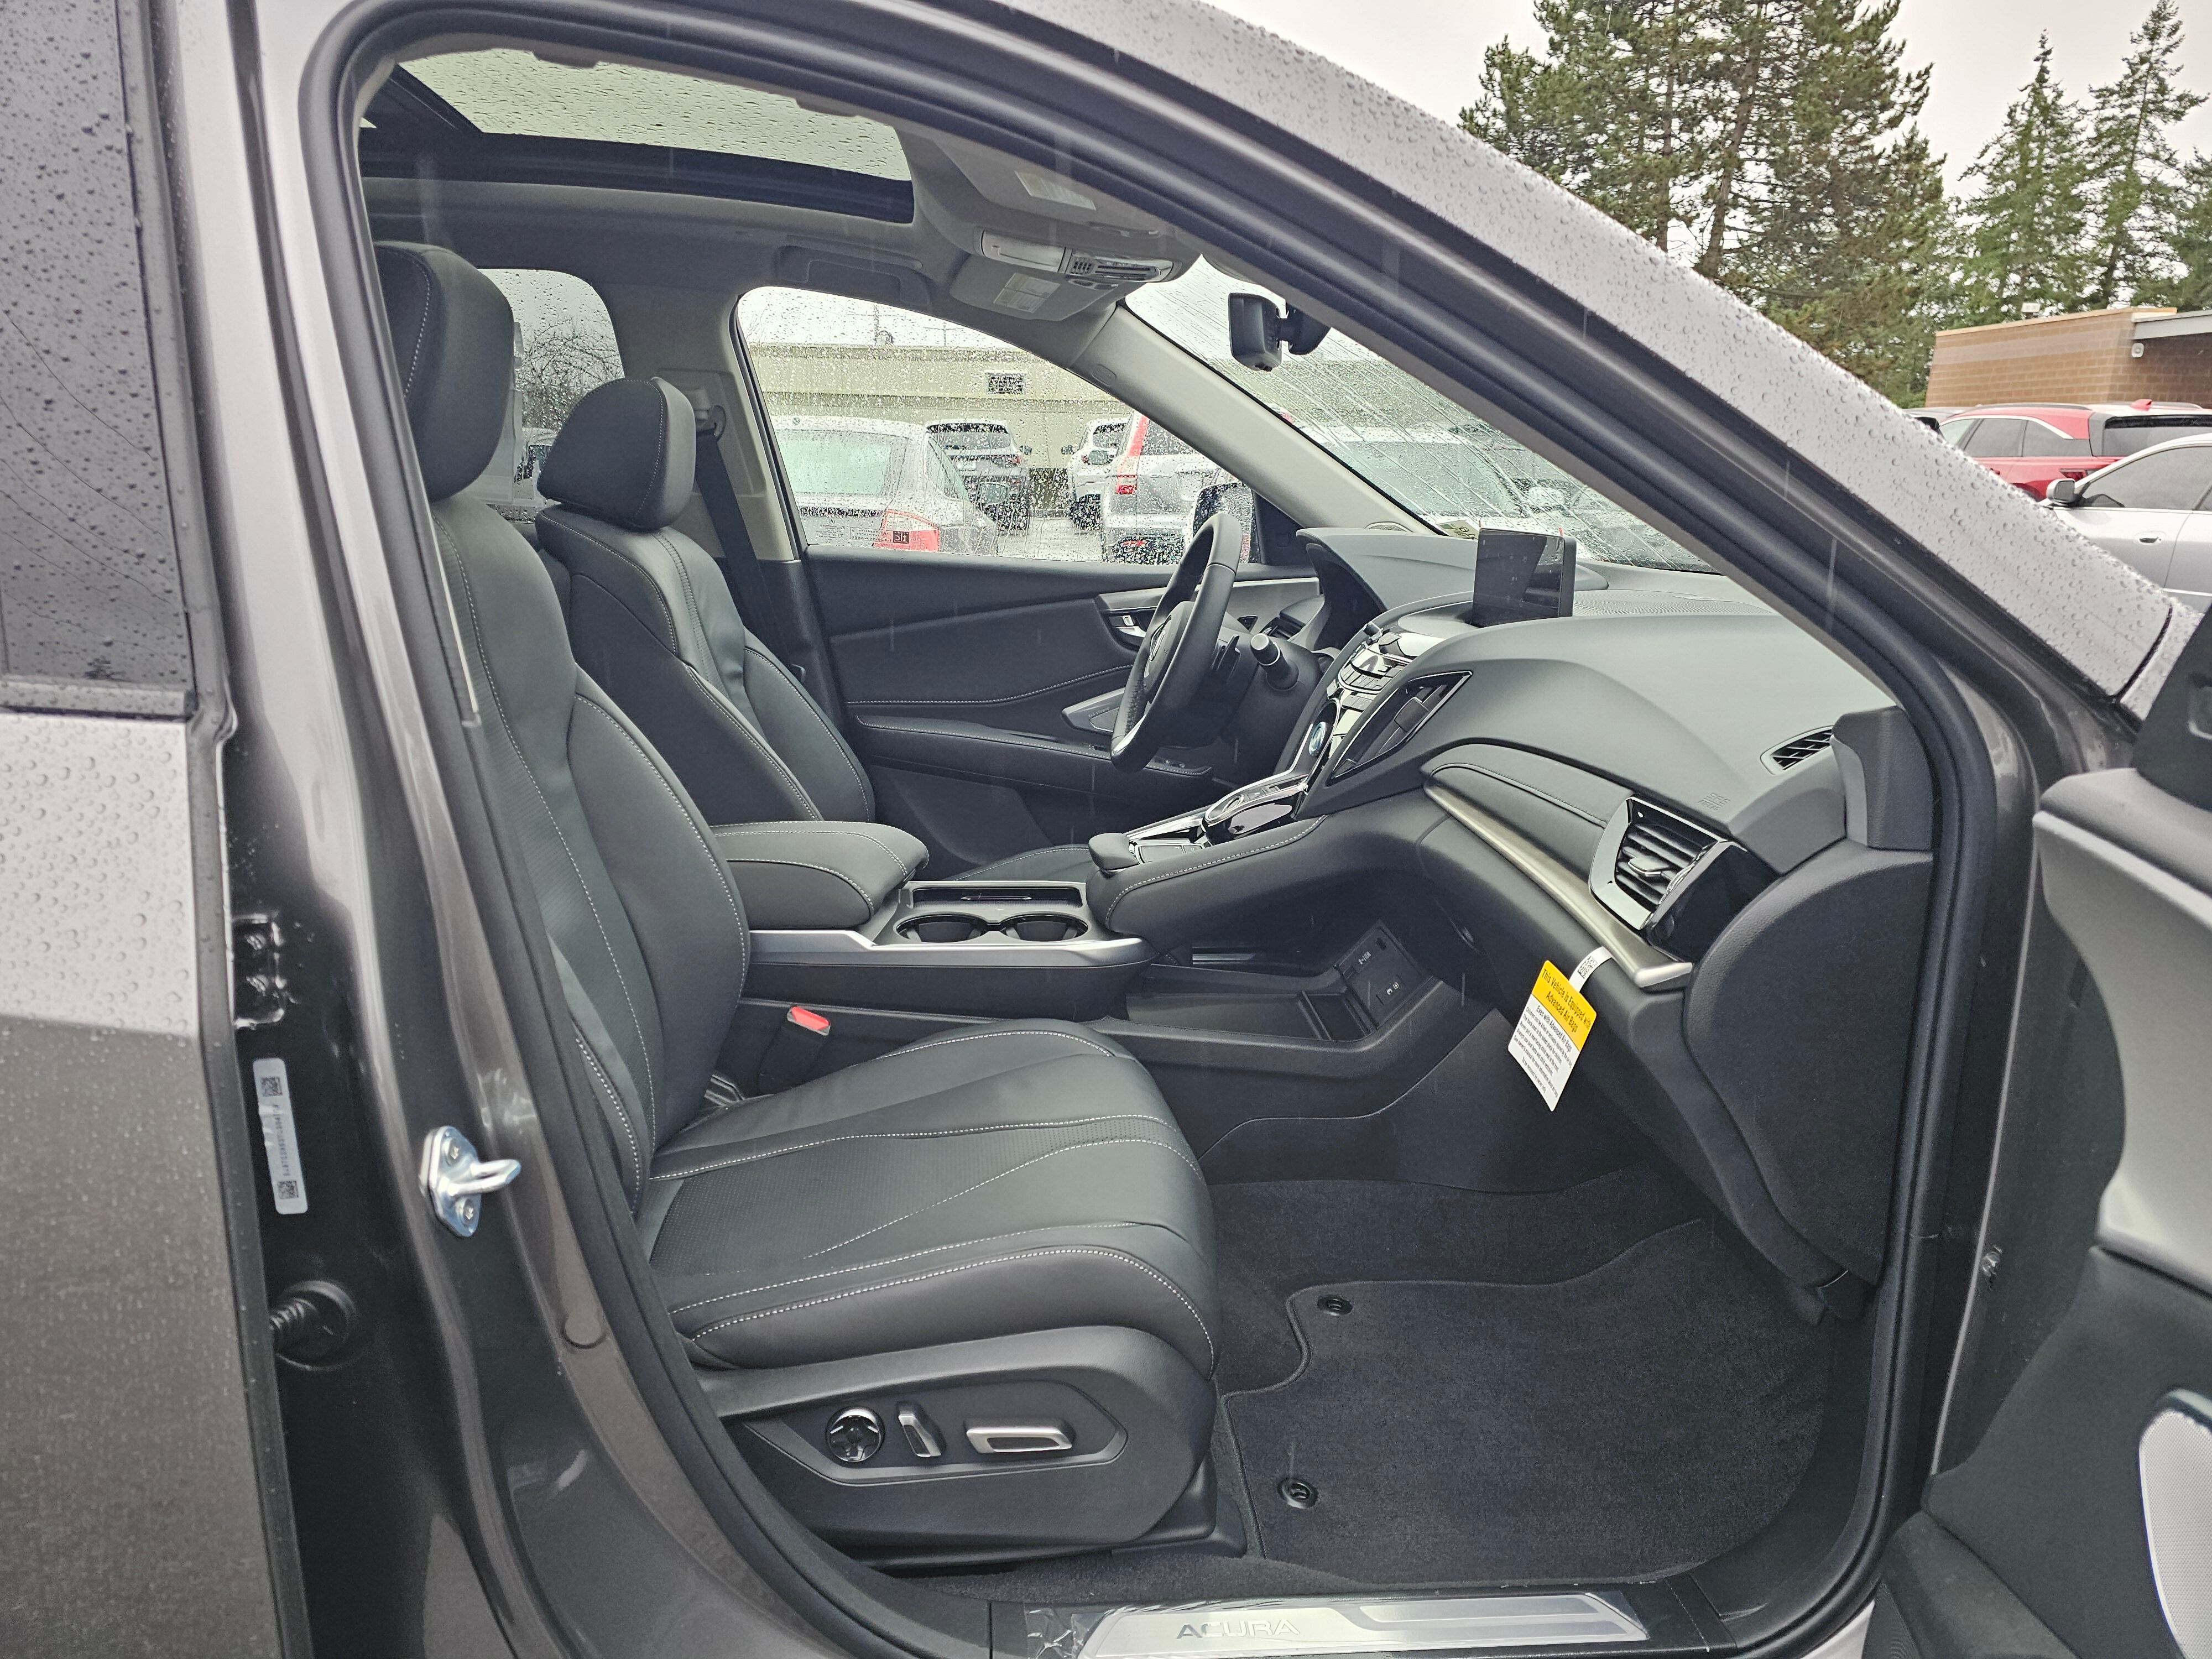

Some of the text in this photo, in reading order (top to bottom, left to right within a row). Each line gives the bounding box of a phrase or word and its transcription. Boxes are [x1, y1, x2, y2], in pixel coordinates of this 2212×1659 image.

[1542, 968, 1551, 983] This
[1551, 977, 1565, 998] Vehicle
[1564, 992, 1569, 1003] is
[1568, 997, 1585, 1021] Equipped
[1546, 991, 1564, 1015] Advanced
[1568, 1016, 1578, 1032] Bags
[1549, 1020, 1563, 1039] Advanced
[1176, 1619, 1300, 1639] ACURA
